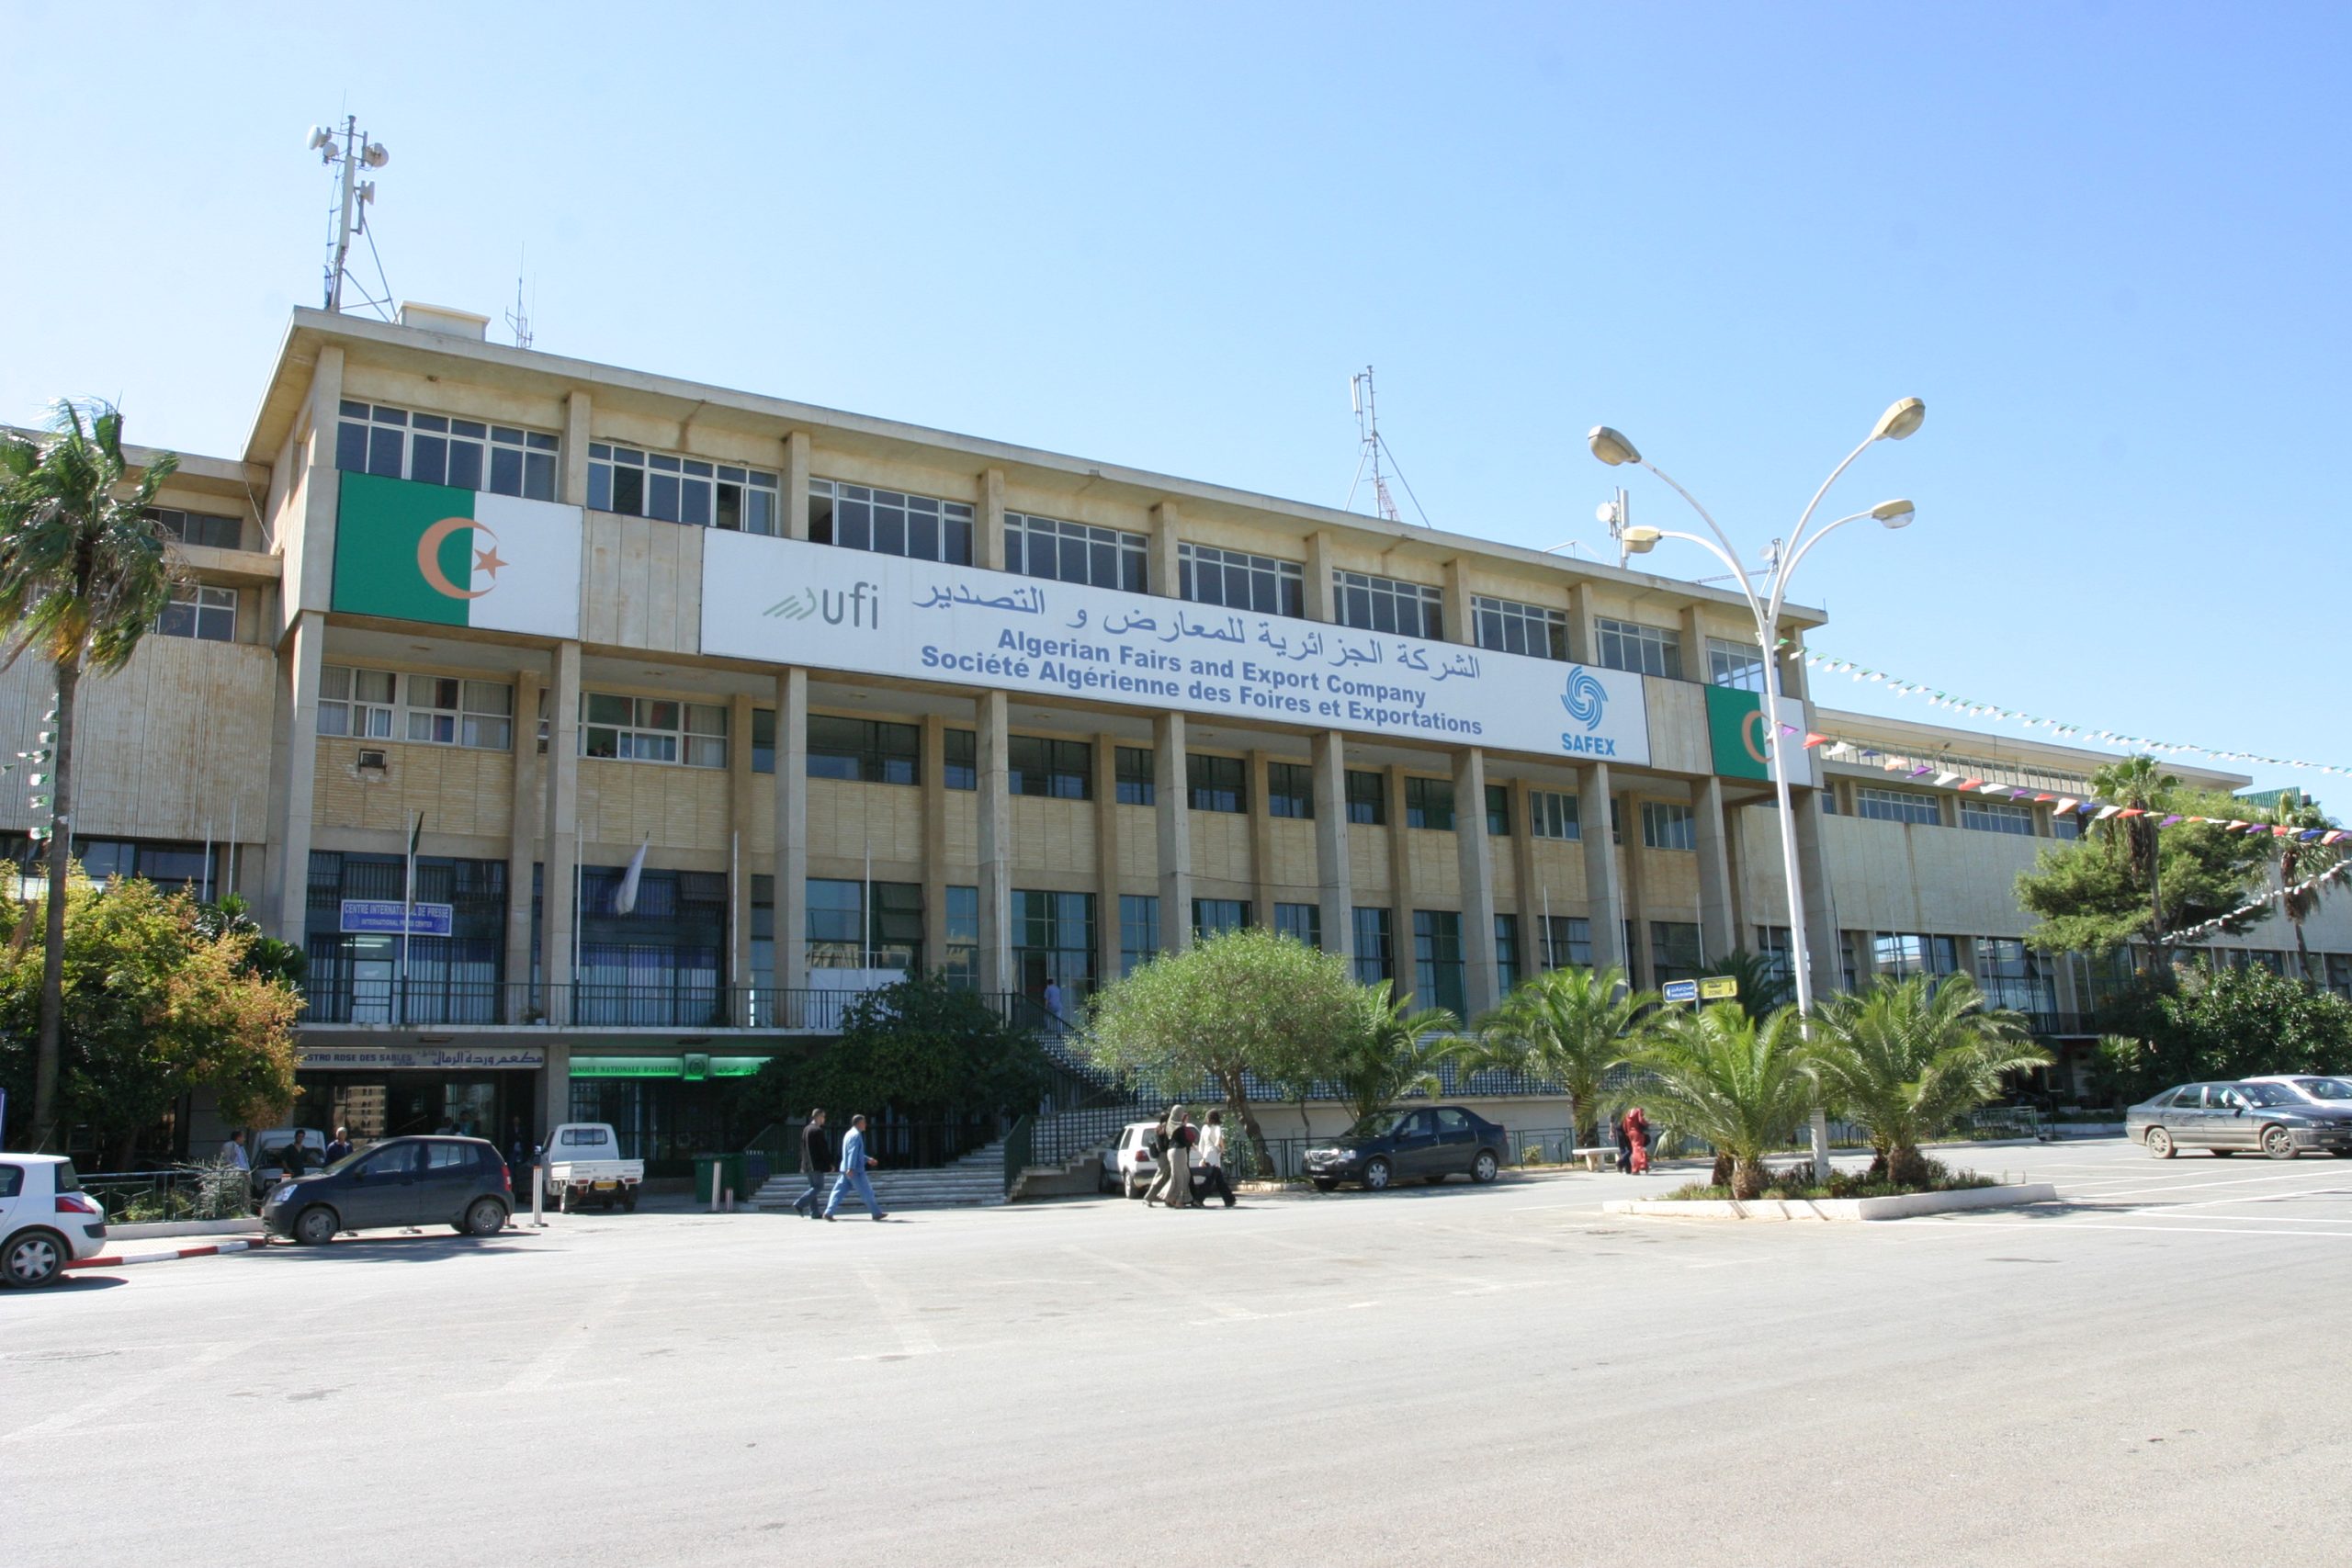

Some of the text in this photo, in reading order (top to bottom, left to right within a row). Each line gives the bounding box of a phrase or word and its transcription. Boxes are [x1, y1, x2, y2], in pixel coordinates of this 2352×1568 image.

[821, 581, 879, 630] ufi
[911, 583, 1481, 682] الشركة الجزائرية للمعارض و التصدير
[922, 646, 1483, 735] Société Algérienne des Foires et Exportations
[998, 628, 1426, 708] Algerian Fairs and Export Company
[1561, 731, 1616, 757] SAFEX
[345, 903, 368, 914] CENTRE
[418, 907, 425, 917] DE
[427, 908, 449, 919] PRESSE
[334, 1054, 356, 1062] ROSE
[359, 1054, 376, 1062] DES
[379, 1054, 413, 1062] SABLES
